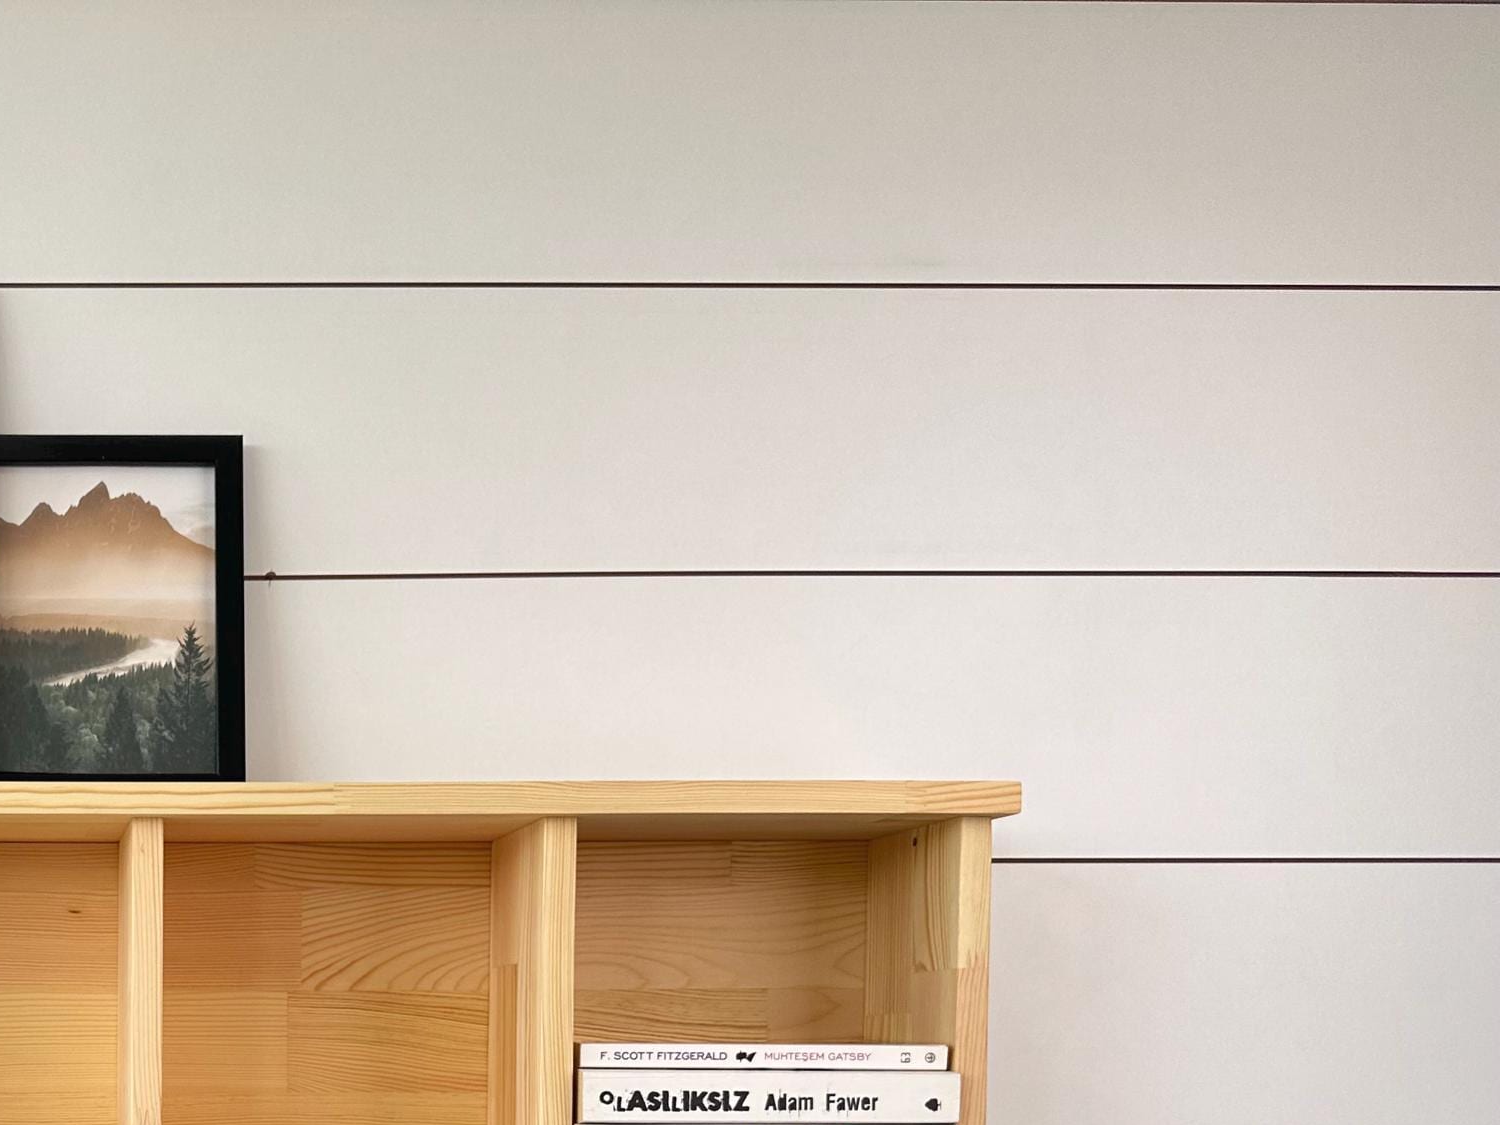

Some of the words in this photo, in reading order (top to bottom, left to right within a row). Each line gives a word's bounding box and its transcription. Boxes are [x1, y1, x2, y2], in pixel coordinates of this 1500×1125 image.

[600, 1051, 611, 1061] F.
[613, 1051, 654, 1061] SCOTT
[656, 1051, 728, 1061] FITZGERALD
[764, 1052, 825, 1062] MUHTEŞEM
[828, 1052, 872, 1062] GATSBY
[764, 1093, 814, 1112] Adam
[825, 1093, 879, 1112] Fawer
